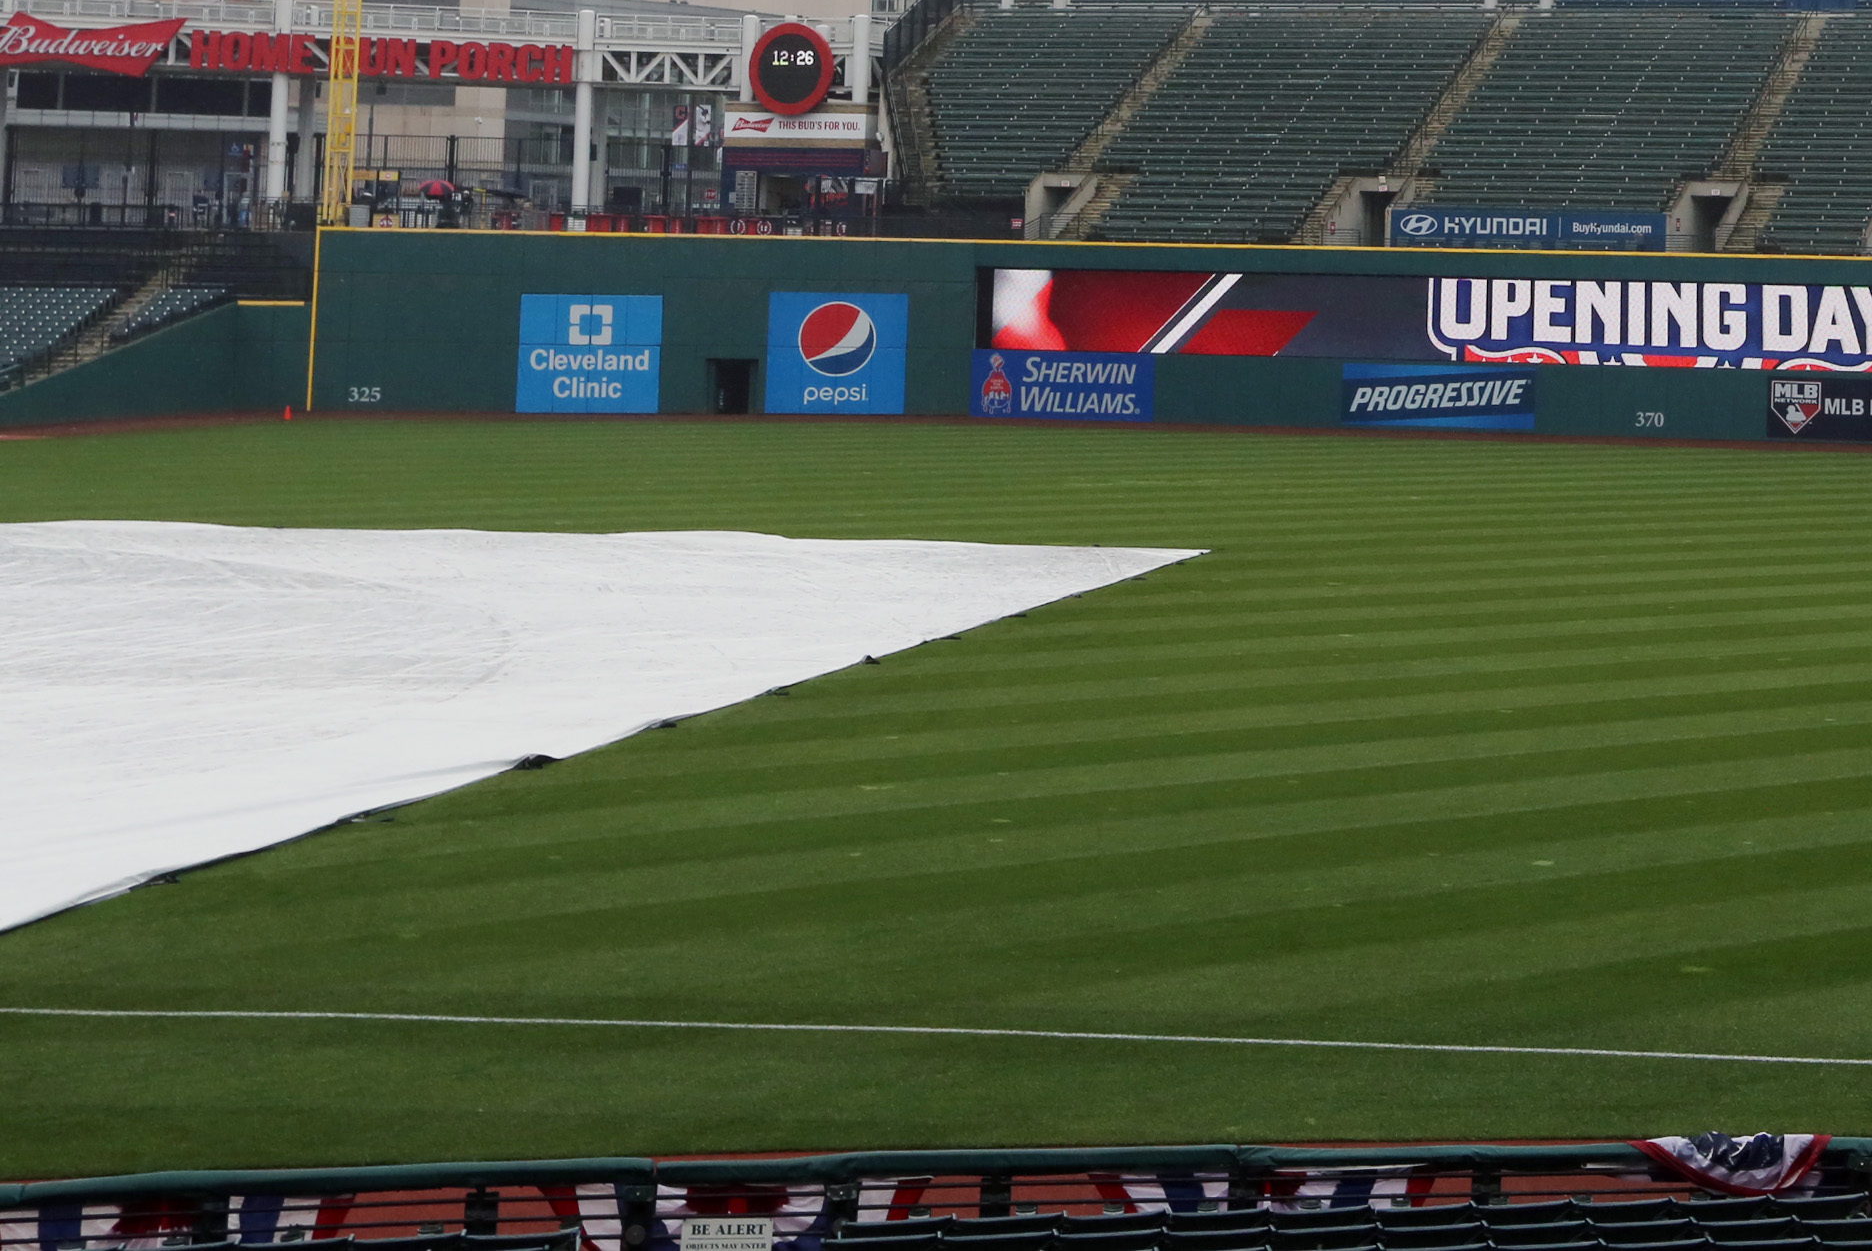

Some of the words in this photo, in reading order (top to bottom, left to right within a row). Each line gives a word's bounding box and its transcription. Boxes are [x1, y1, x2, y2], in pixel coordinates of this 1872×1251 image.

[0, 24, 165, 59] Budweiser
[190, 30, 316, 74] HOME
[429, 39, 573, 84] PORCH
[771, 50, 815, 67] 12:26
[778, 120, 797, 130] THIS
[798, 120, 822, 131] BUD'S
[824, 121, 840, 131] FOR
[842, 121, 861, 132] YOU.
[1444, 216, 1547, 235] HYUNDAI
[1572, 221, 1652, 235] BuyHyundai.com
[530, 349, 650, 372] Cleveland
[1022, 356, 1137, 385] SHERWIN
[348, 387, 381, 402] 325
[553, 376, 622, 399] Clinic
[803, 383, 867, 405] pepsi
[1349, 379, 1526, 412] PROGRESSIVE
[1774, 383, 1818, 399] MLB
[1020, 386, 1136, 415] WILLIAMS
[1774, 397, 1818, 405] NETWORK
[1824, 398, 1865, 416] MLB
[1635, 412, 1664, 428] 370
[691, 1224, 711, 1235] BE
[715, 1223, 767, 1235] ALERT
